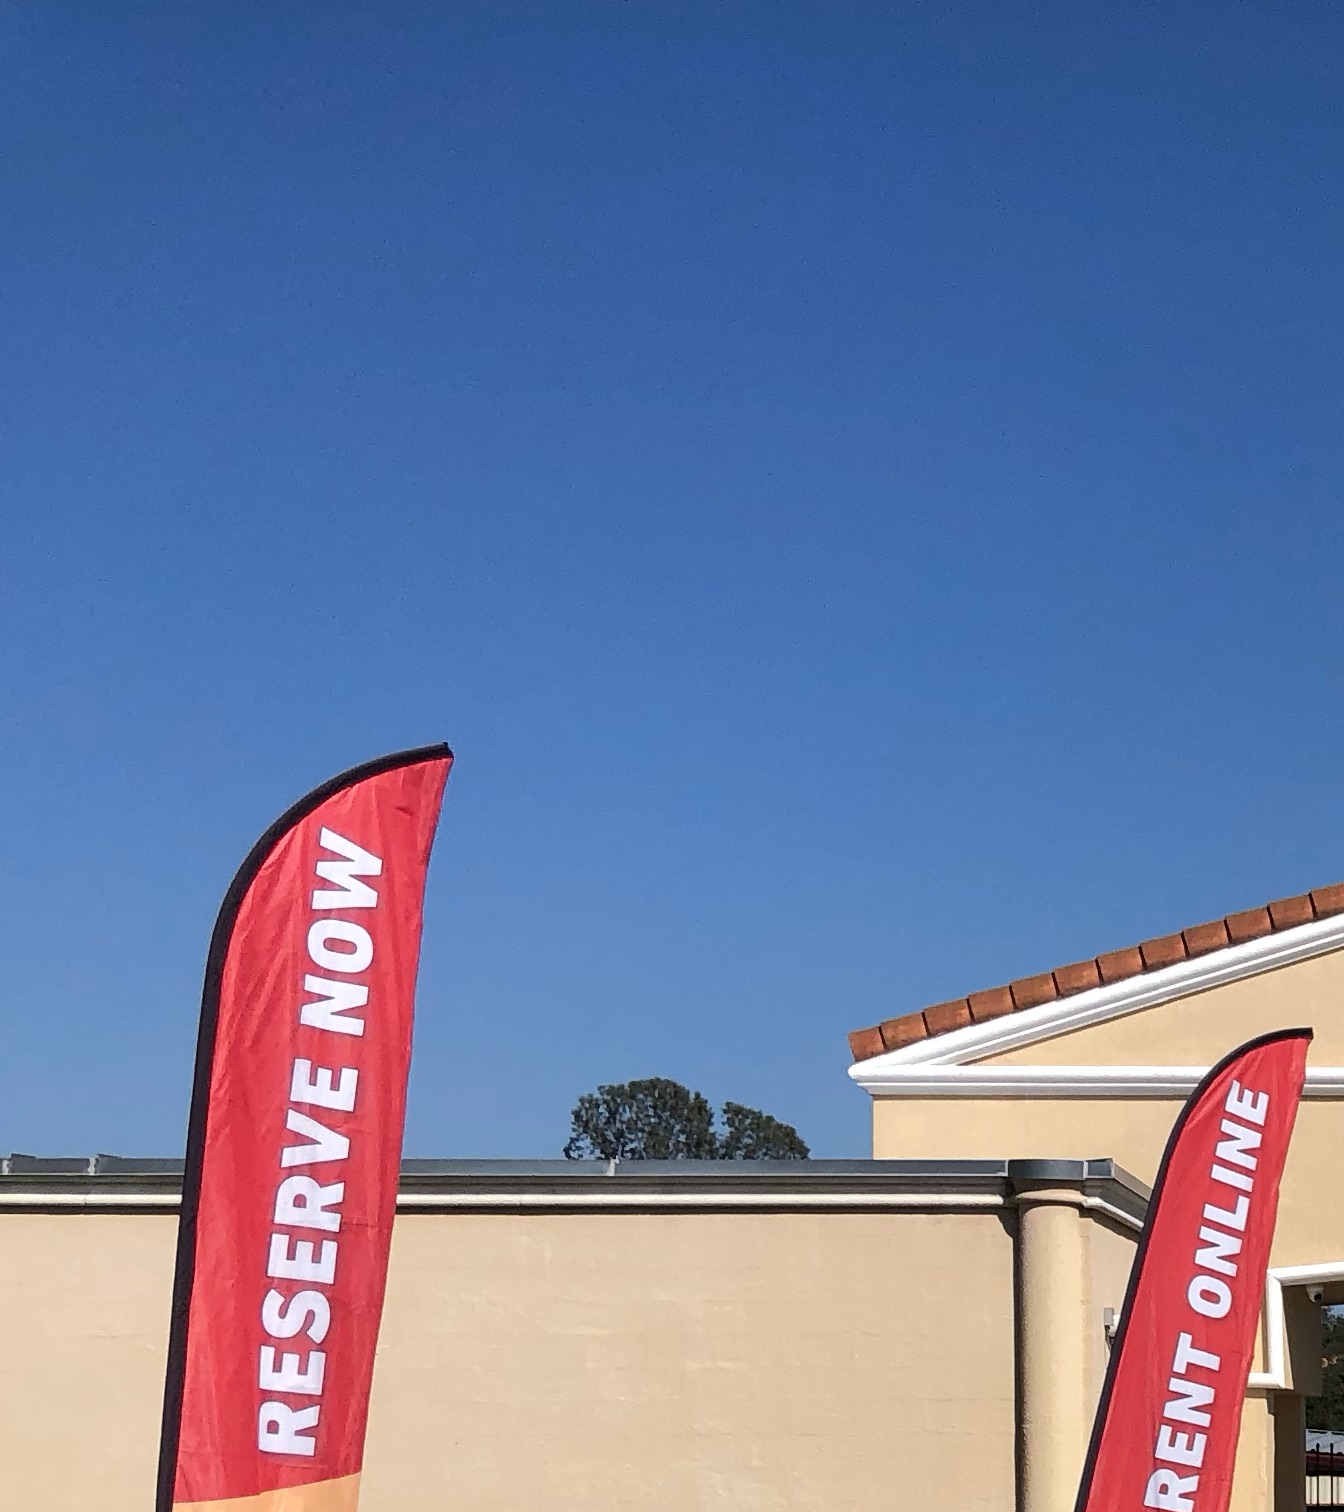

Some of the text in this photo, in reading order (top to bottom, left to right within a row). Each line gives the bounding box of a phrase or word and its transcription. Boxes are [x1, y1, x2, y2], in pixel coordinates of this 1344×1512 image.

[258, 826, 383, 1457] RESERVE NOW
[1187, 1079, 1270, 1320] ONLINE
